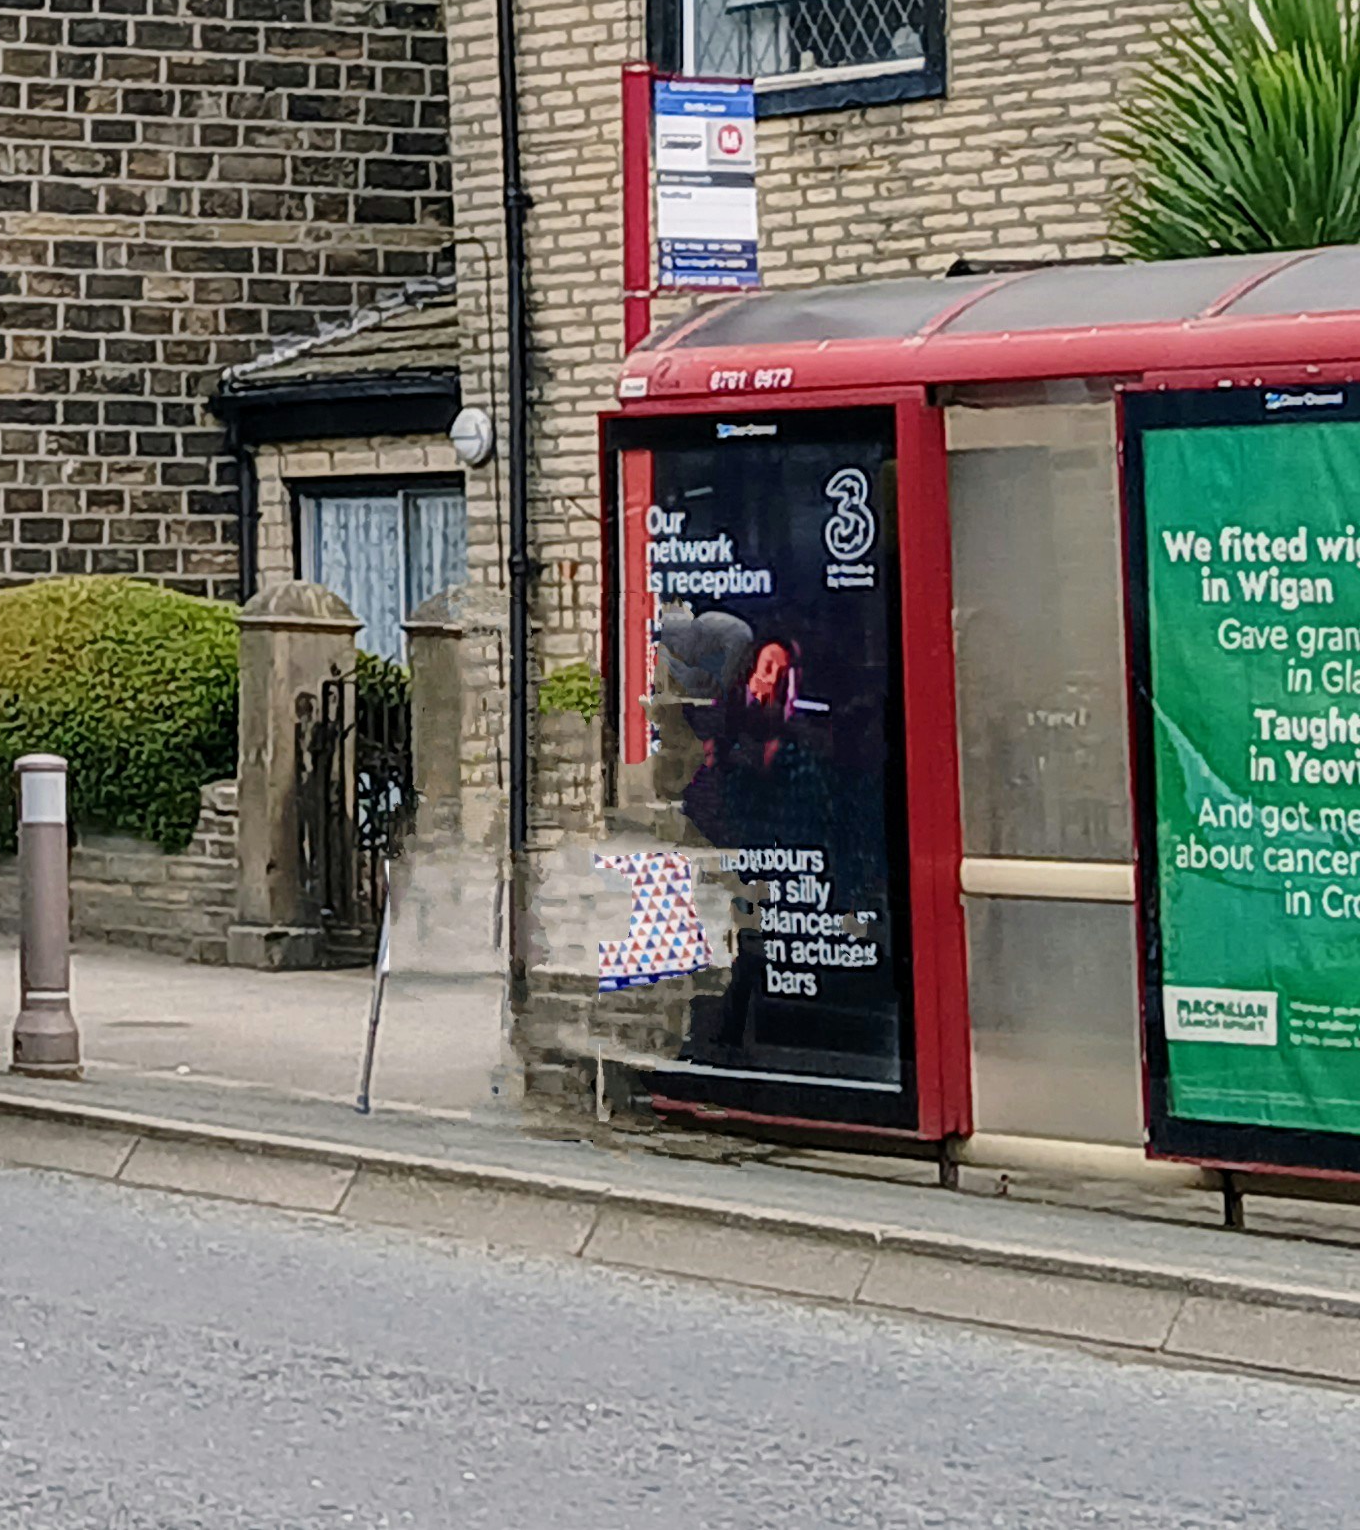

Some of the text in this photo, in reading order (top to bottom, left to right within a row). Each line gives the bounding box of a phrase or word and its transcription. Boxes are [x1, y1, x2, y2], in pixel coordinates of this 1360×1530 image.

[645, 505, 686, 535] Our
[645, 533, 734, 563] network
[1162, 524, 1360, 569] We fitted wi
[646, 563, 772, 600] is reception
[1201, 566, 1334, 610] in Wigan
[1218, 617, 1289, 651] Gave
[1287, 657, 1313, 693] in
[1253, 706, 1360, 750] Taught
[1249, 745, 1276, 781] in
[1198, 796, 1254, 829] And
[1261, 801, 1314, 838] got
[1175, 833, 1360, 876] about cancer
[1284, 880, 1311, 916] in
[766, 963, 818, 996] bars
